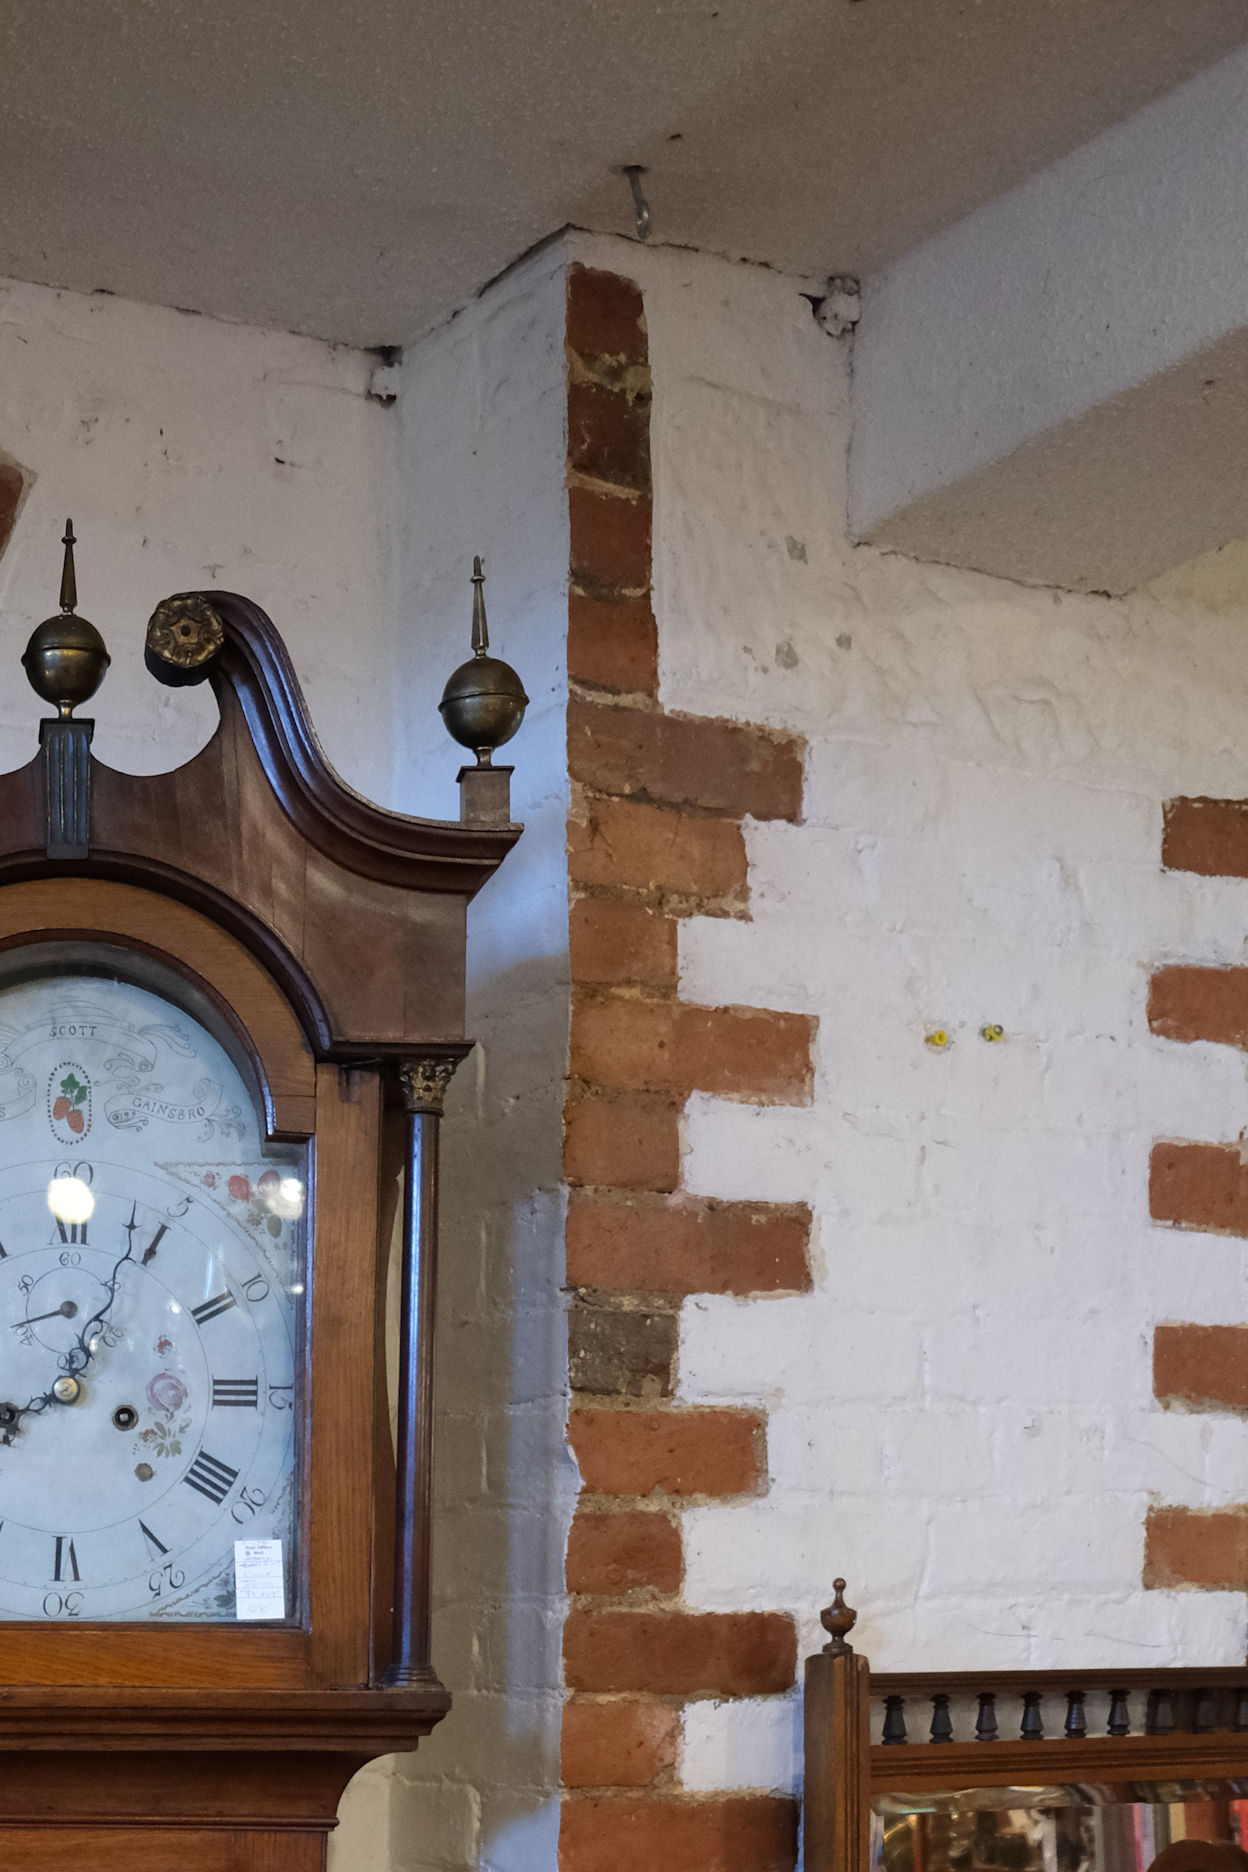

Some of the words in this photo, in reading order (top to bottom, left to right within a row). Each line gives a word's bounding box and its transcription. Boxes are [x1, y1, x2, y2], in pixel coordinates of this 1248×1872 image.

[48, 1025, 98, 1038] SCOTT
[167, 1197, 194, 1217] 5
[59, 1251, 81, 1266] 60
[18, 1275, 34, 1297] 50
[241, 1272, 270, 1302] 10
[269, 1383, 293, 1411] 15
[230, 1486, 266, 1525] 20
[148, 1563, 185, 1600] 25
[42, 1591, 85, 1617] 30
